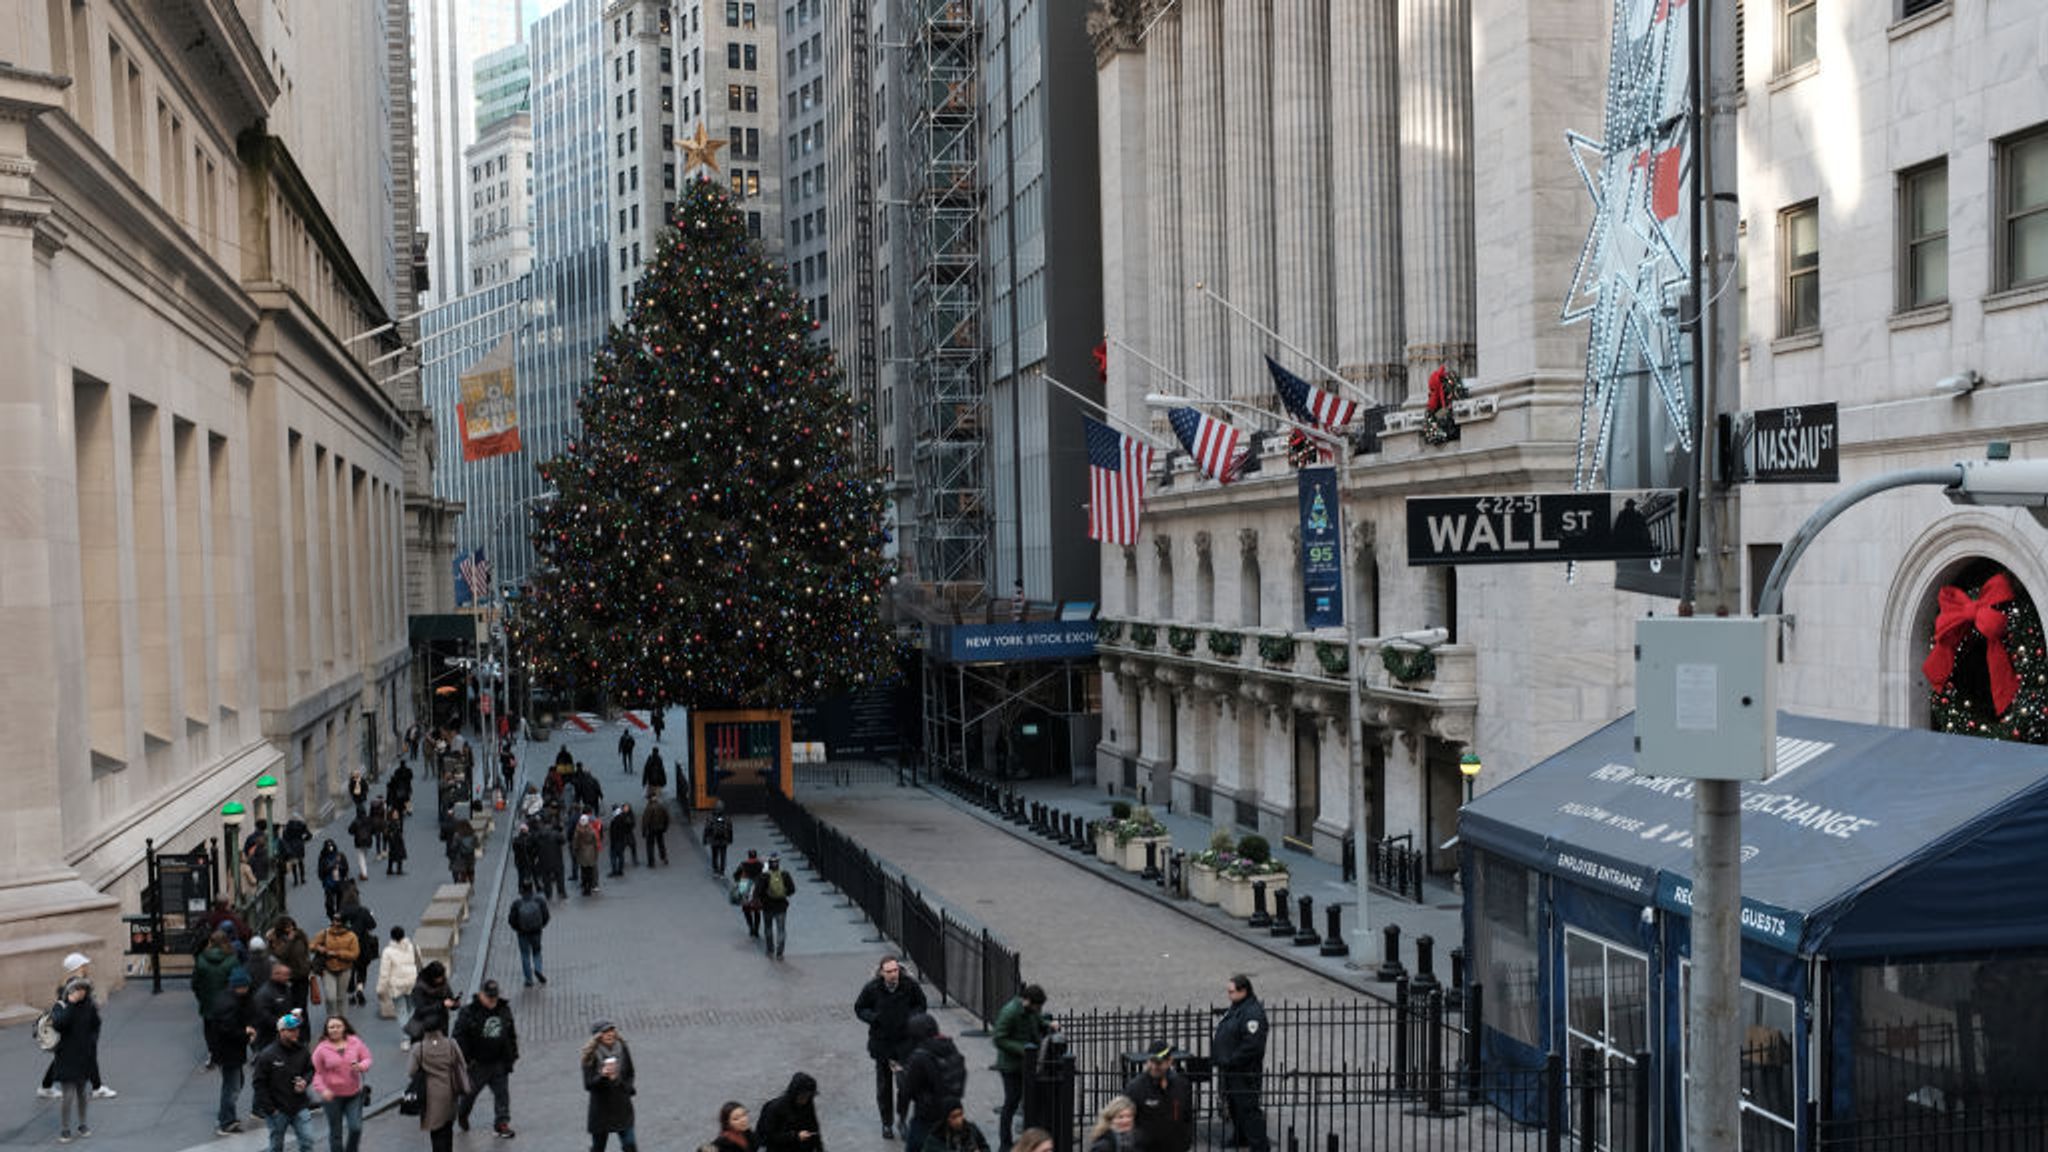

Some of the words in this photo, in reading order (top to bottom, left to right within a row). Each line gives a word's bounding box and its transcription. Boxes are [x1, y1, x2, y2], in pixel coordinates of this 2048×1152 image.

[1758, 425, 1819, 470] NASSAU
[1821, 424, 1833, 449] ST
[1493, 496, 1541, 514] 22-51
[1428, 514, 1560, 553] WALL
[1562, 510, 1592, 531] ST
[1310, 547, 1333, 562] 95
[966, 637, 991, 648] NEW
[994, 636, 1024, 646] YORK
[1025, 634, 1062, 645] STOCK
[1742, 793, 1879, 838] EXCHANGE
[1558, 852, 1598, 878] EMPLOYEE
[1598, 865, 1643, 892] ENTRANCE
[1741, 907, 1786, 937] GUESTS
